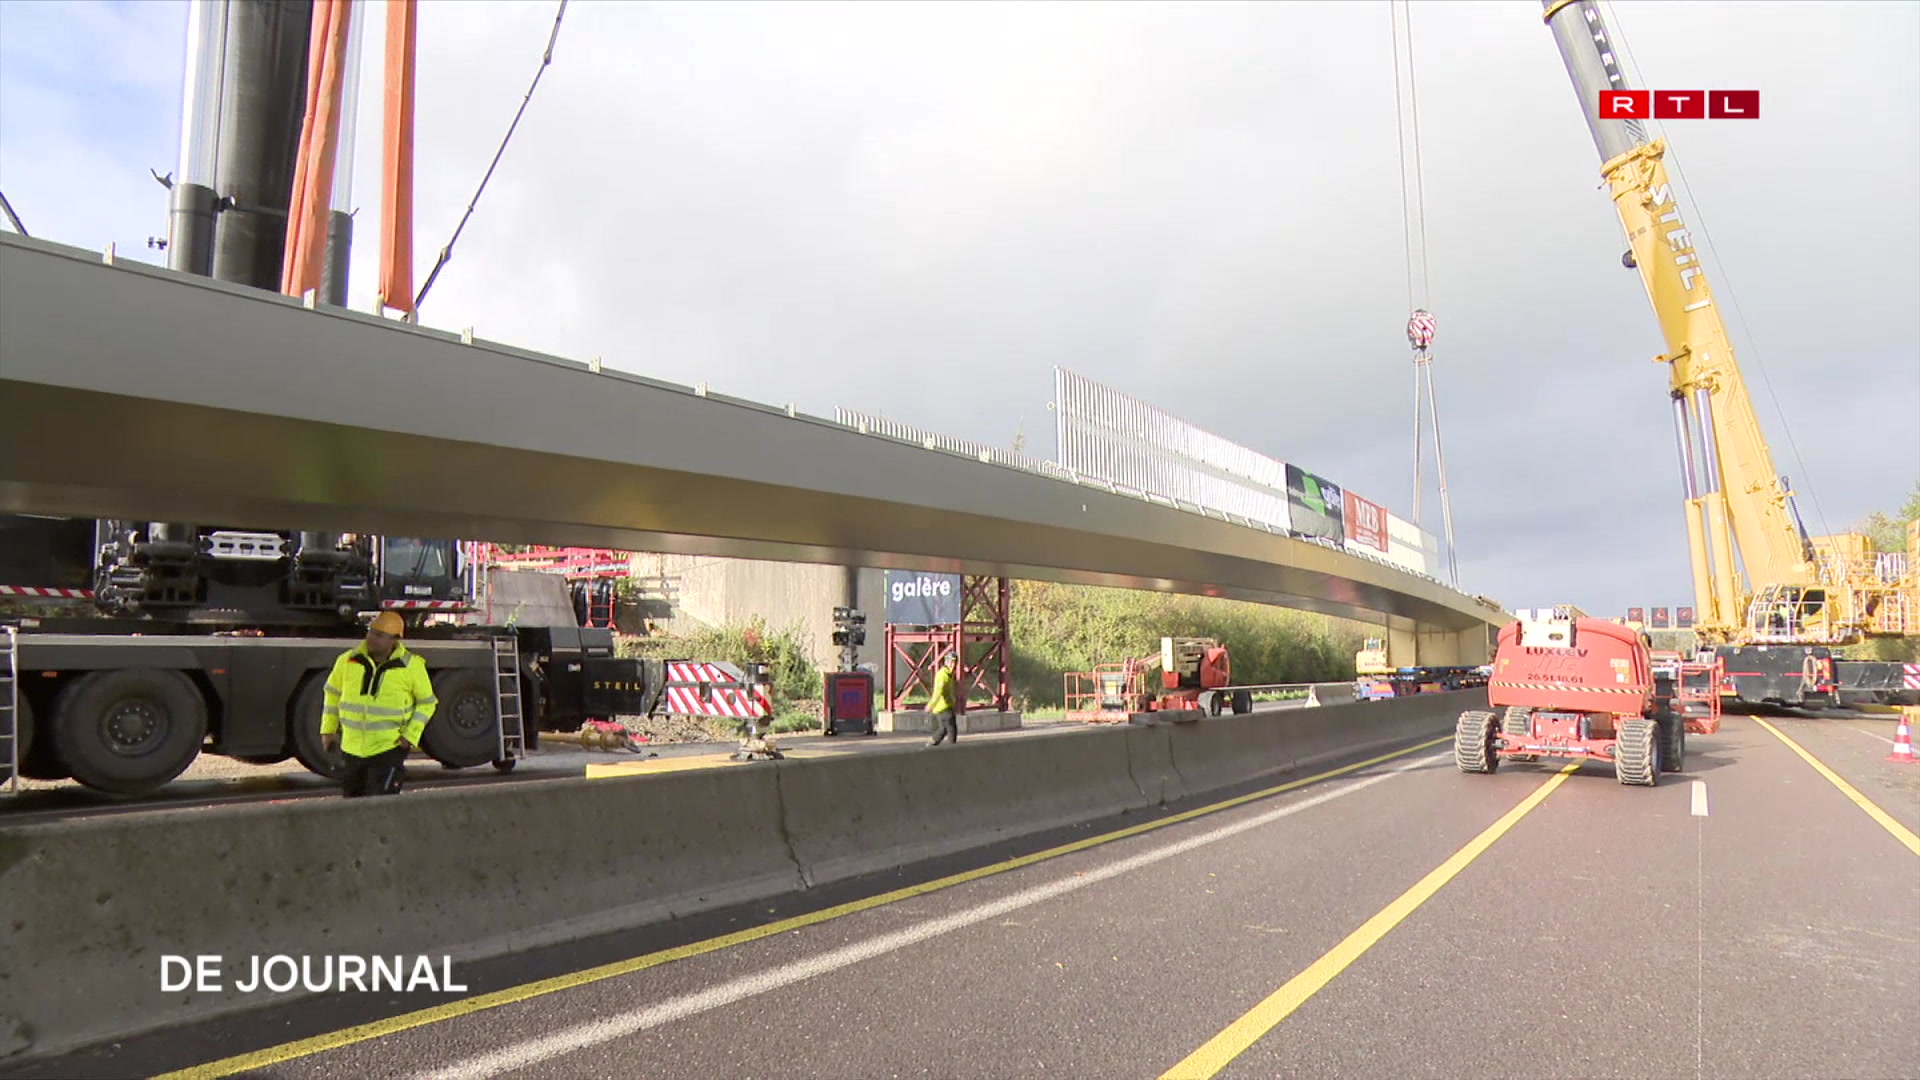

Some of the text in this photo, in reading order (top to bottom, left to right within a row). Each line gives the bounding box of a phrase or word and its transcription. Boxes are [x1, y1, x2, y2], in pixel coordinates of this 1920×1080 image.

[1585, 9, 1620, 82] STEI
[1648, 183, 1702, 291] STEIL
[891, 576, 951, 602] galère
[594, 681, 641, 691] STEIL
